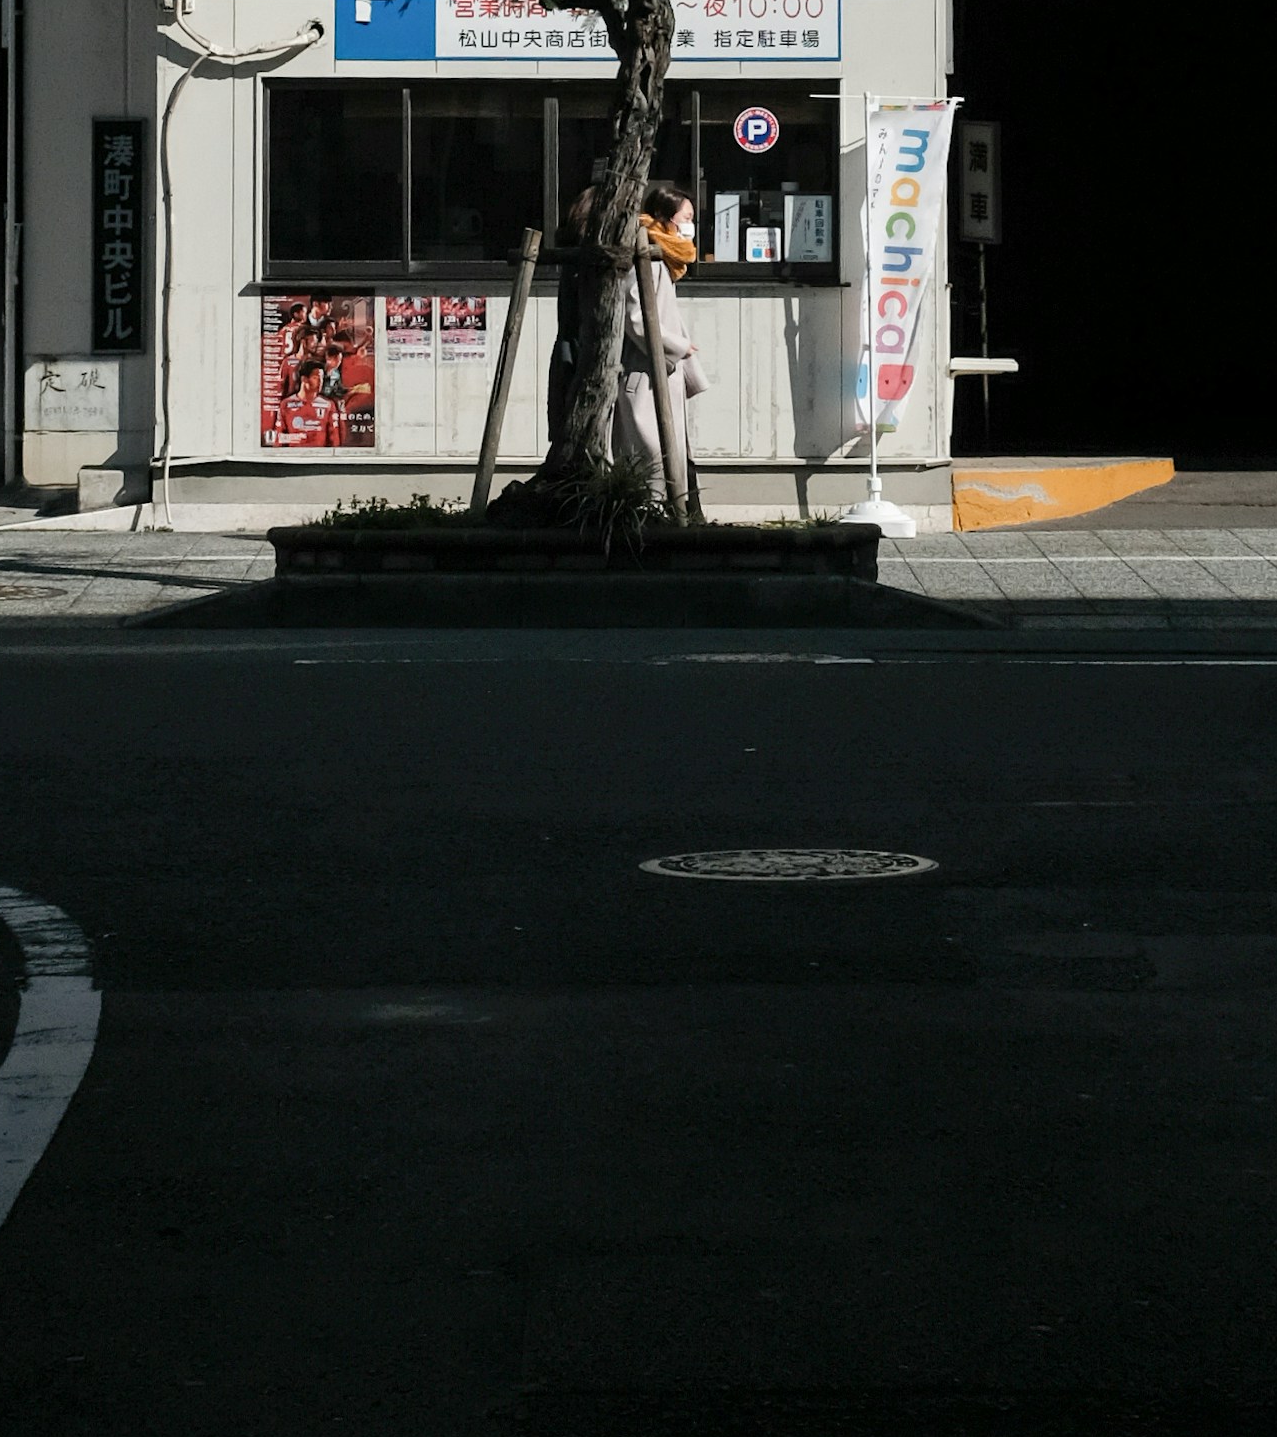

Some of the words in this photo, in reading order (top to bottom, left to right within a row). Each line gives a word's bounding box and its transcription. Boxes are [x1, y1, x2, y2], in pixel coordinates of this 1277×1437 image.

[713, 29, 821, 50] 指定駐車場
[747, 119, 768, 142] P
[102, 134, 135, 341] 湊町中央ビル
[874, 128, 931, 355] machica
